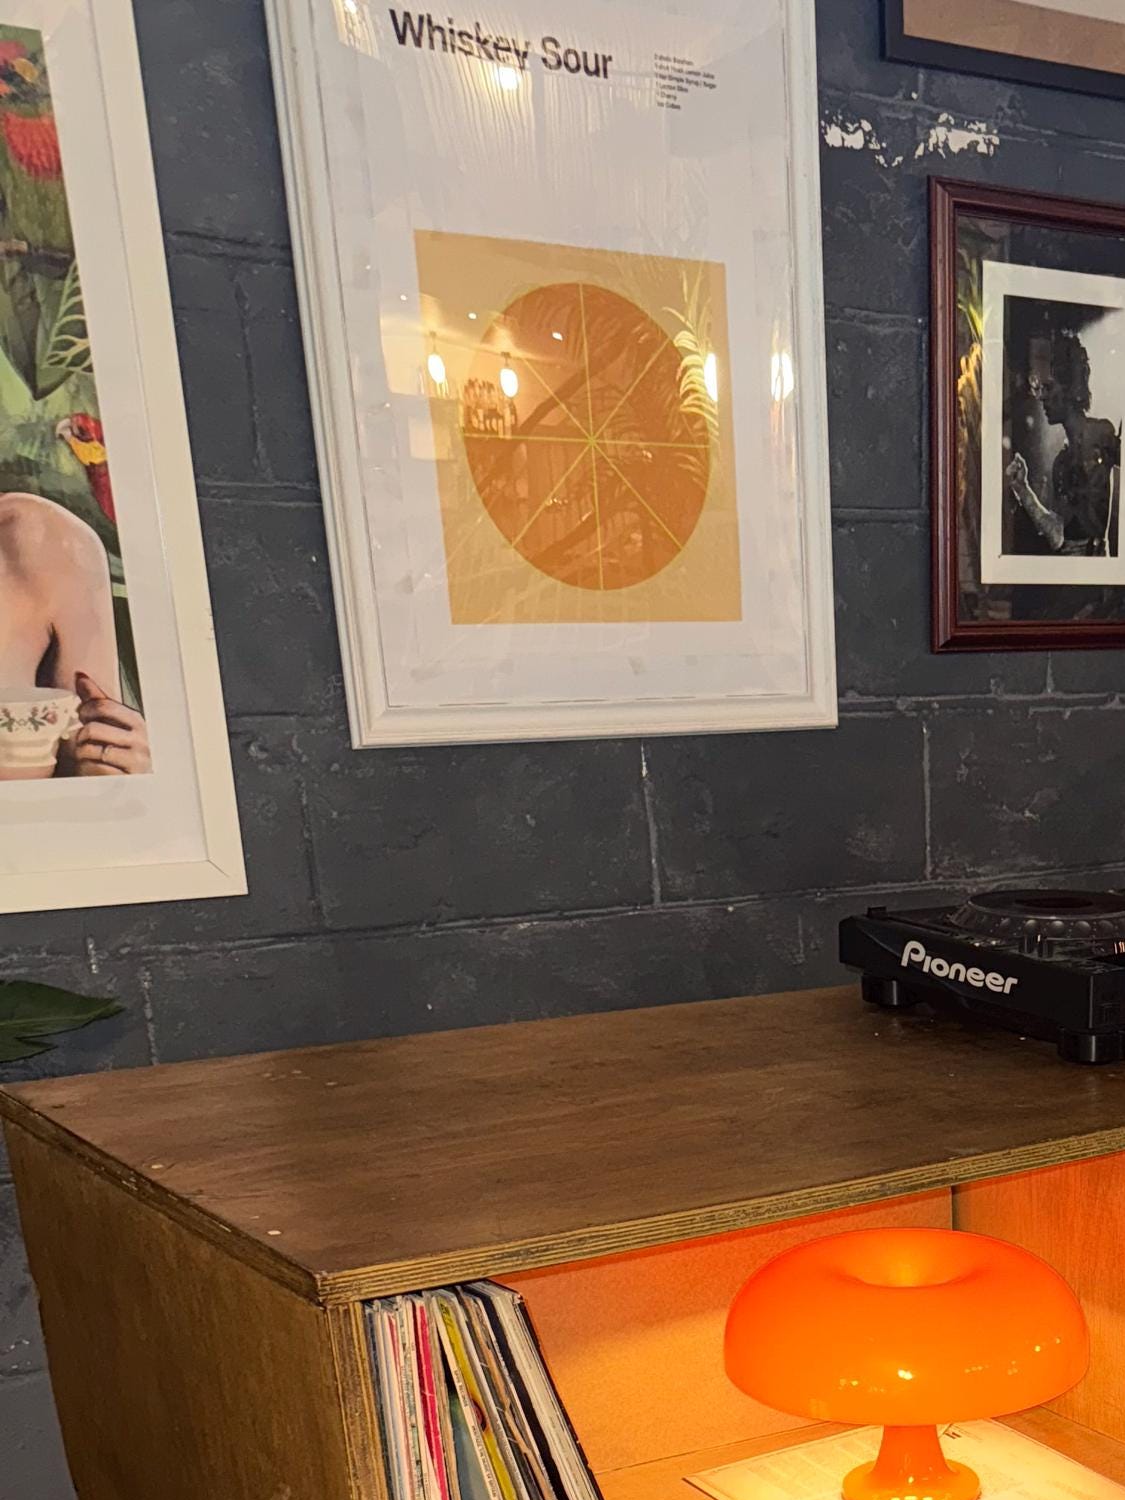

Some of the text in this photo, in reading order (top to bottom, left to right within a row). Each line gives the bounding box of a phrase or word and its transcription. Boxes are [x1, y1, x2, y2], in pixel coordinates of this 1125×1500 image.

[389, 8, 612, 79] Whiskey Sour
[901, 940, 1018, 994] Pioneer
